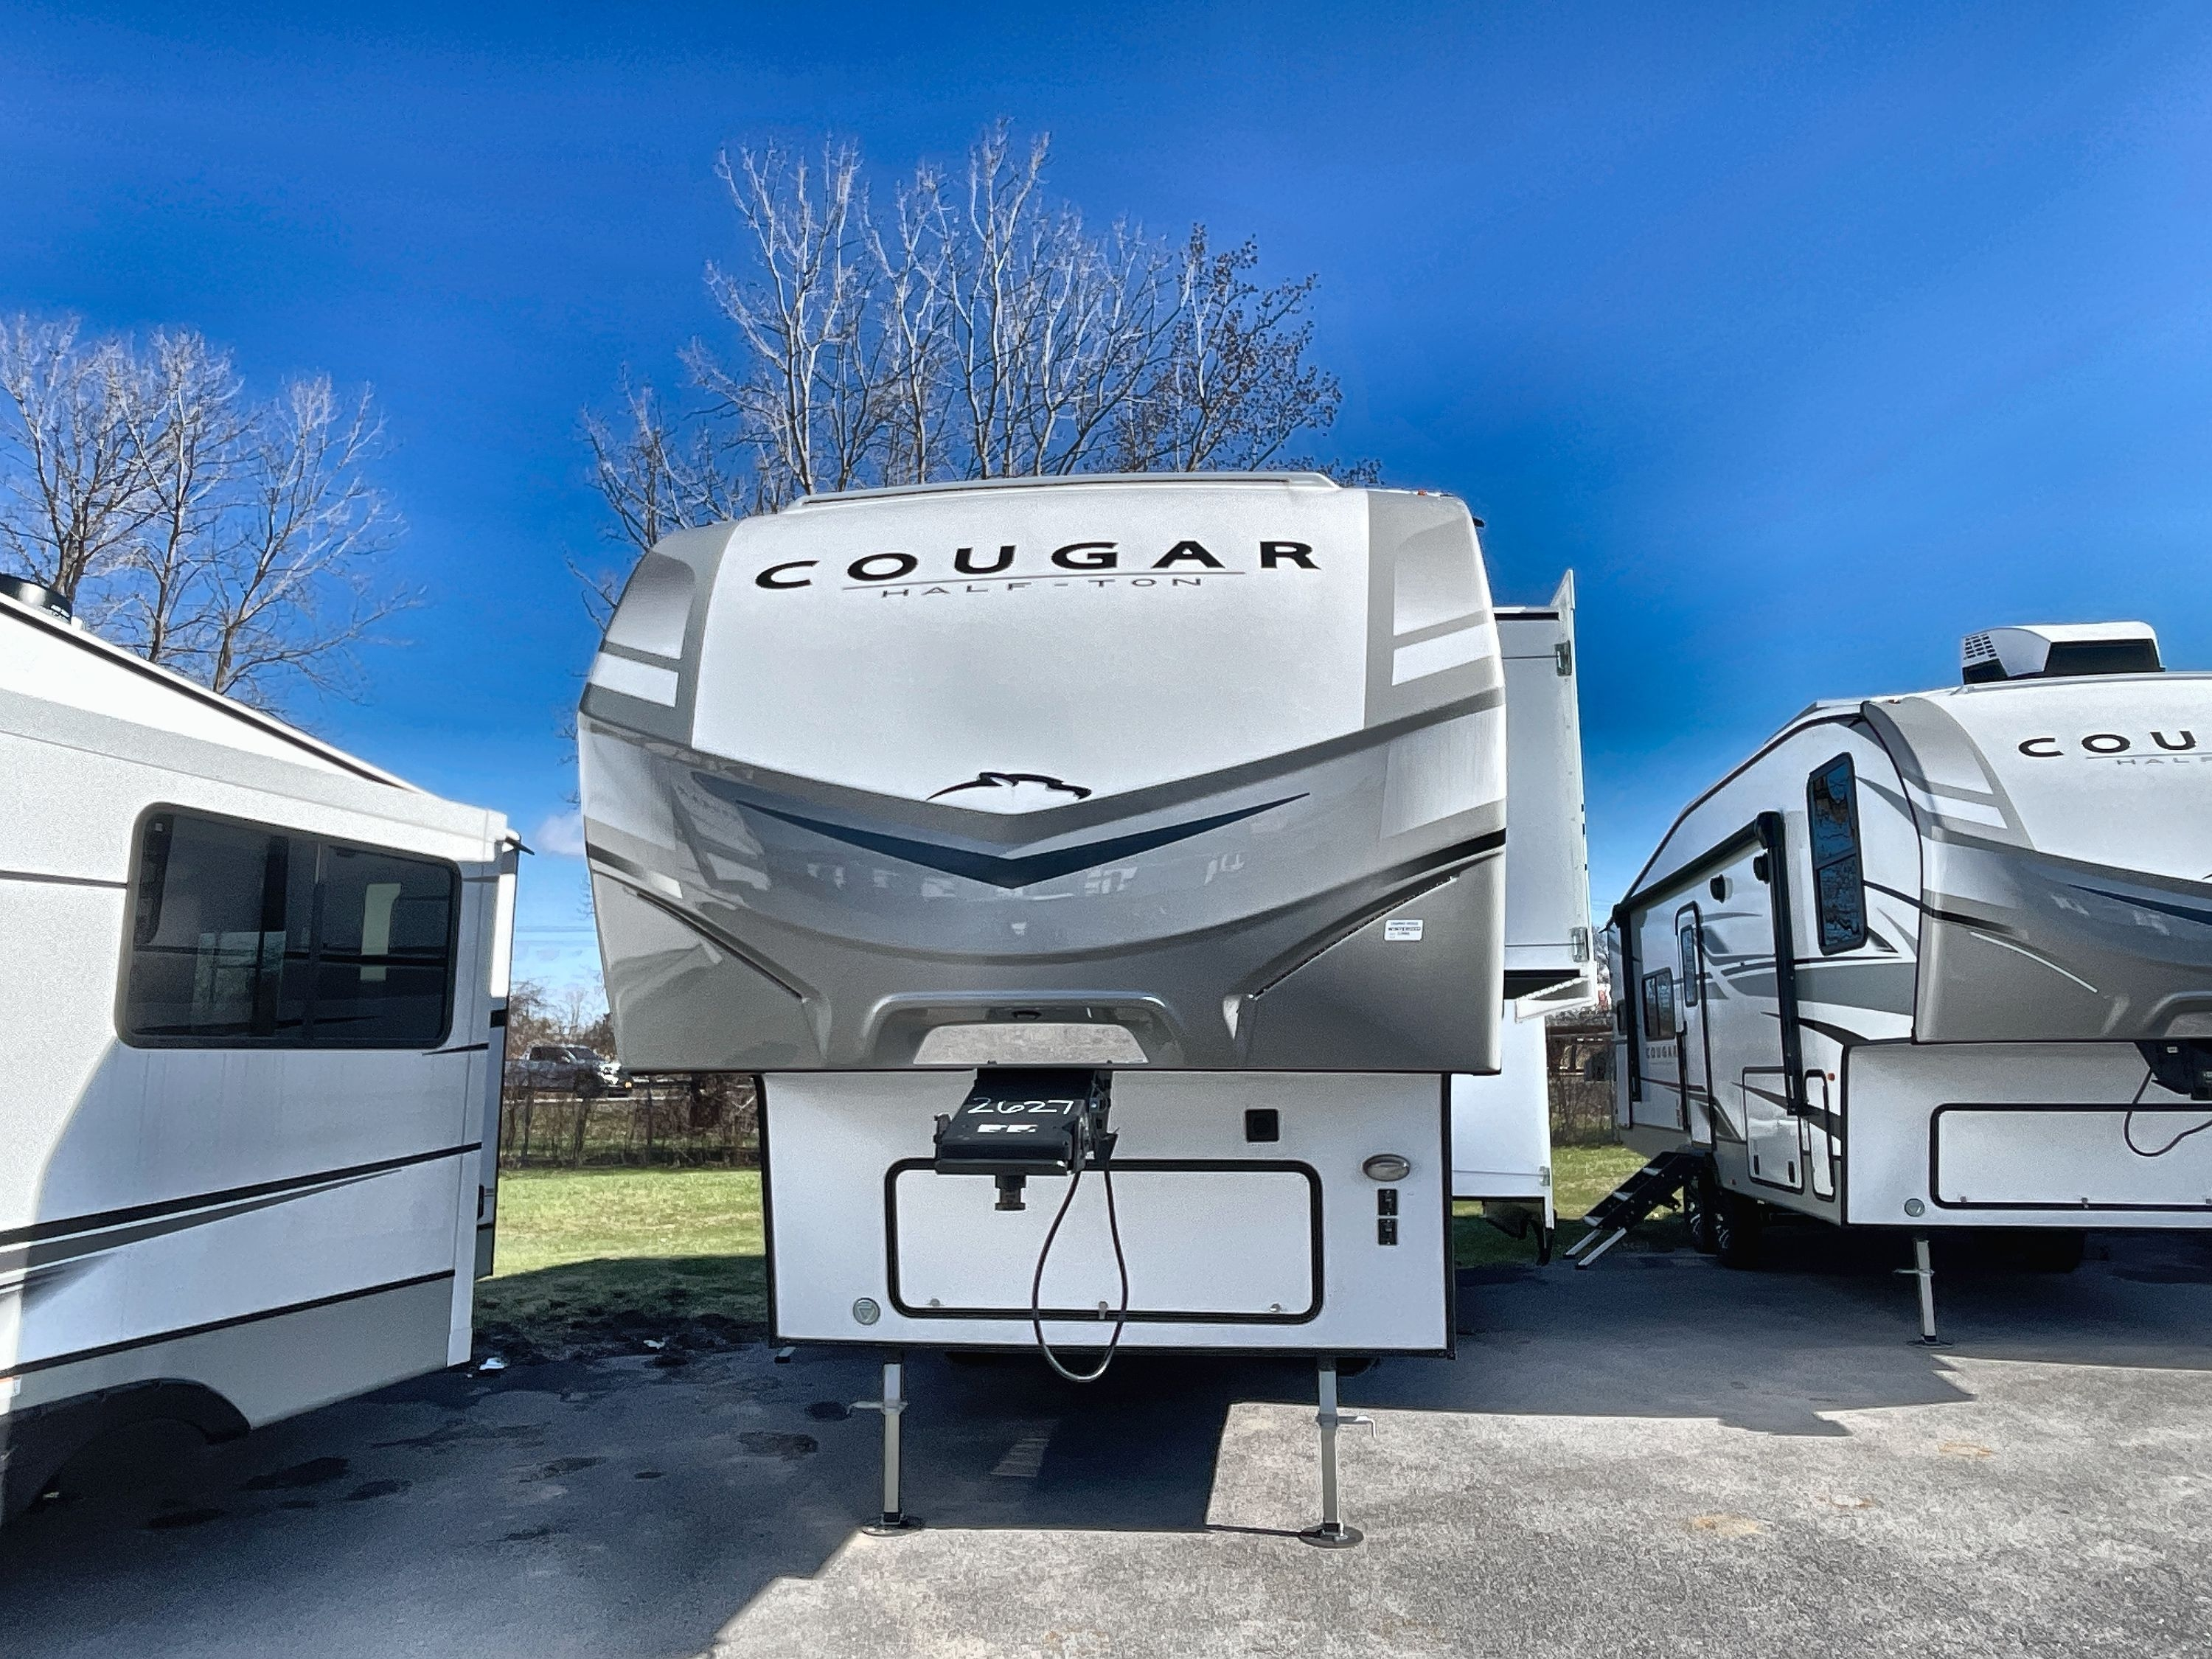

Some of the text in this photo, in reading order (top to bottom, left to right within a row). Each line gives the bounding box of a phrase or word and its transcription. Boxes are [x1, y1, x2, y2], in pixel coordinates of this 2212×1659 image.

[754, 540, 1322, 591] COUGAR
[882, 578, 1201, 597] HALF-TON
[2018, 730, 2197, 757] COU
[967, 1096, 1074, 1115] 2627
